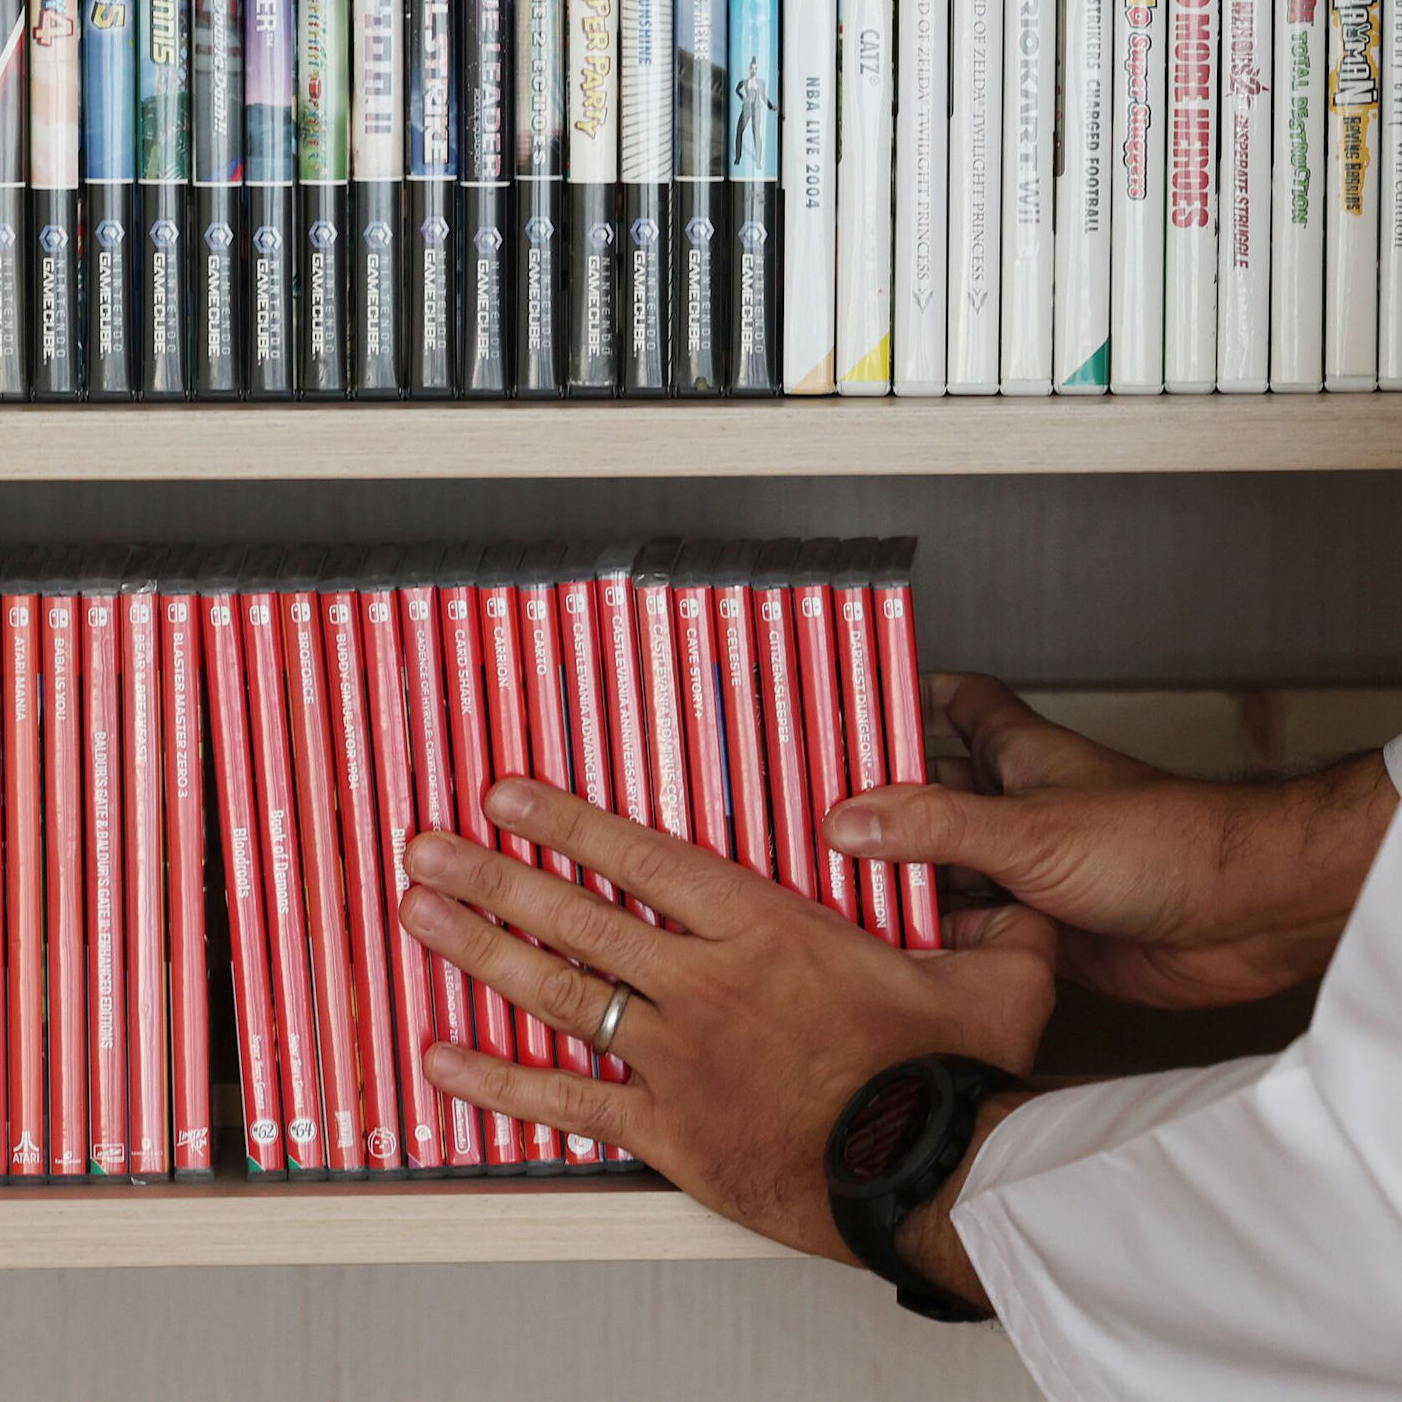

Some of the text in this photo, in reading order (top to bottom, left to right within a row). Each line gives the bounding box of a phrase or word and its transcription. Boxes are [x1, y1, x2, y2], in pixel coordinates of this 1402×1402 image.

[974, 23, 987, 44] OF
[1174, 18, 1209, 102] MORE
[805, 77, 821, 209] NBA LIVE 2004
[973, 111, 988, 198] TWILIGHT
[1171, 109, 1208, 227] HEROES
[971, 202, 987, 280] PRINCESS
[54, 638, 66, 720] BABA IS YOU
[454, 629, 472, 715] CARD SHARK
[493, 627, 507, 687] CARRION
[533, 629, 547, 675] CARTO
[769, 631, 788, 744] CITIZEN SLEEPER
[173, 633, 188, 797] BLASTER MASTER ZERO 3
